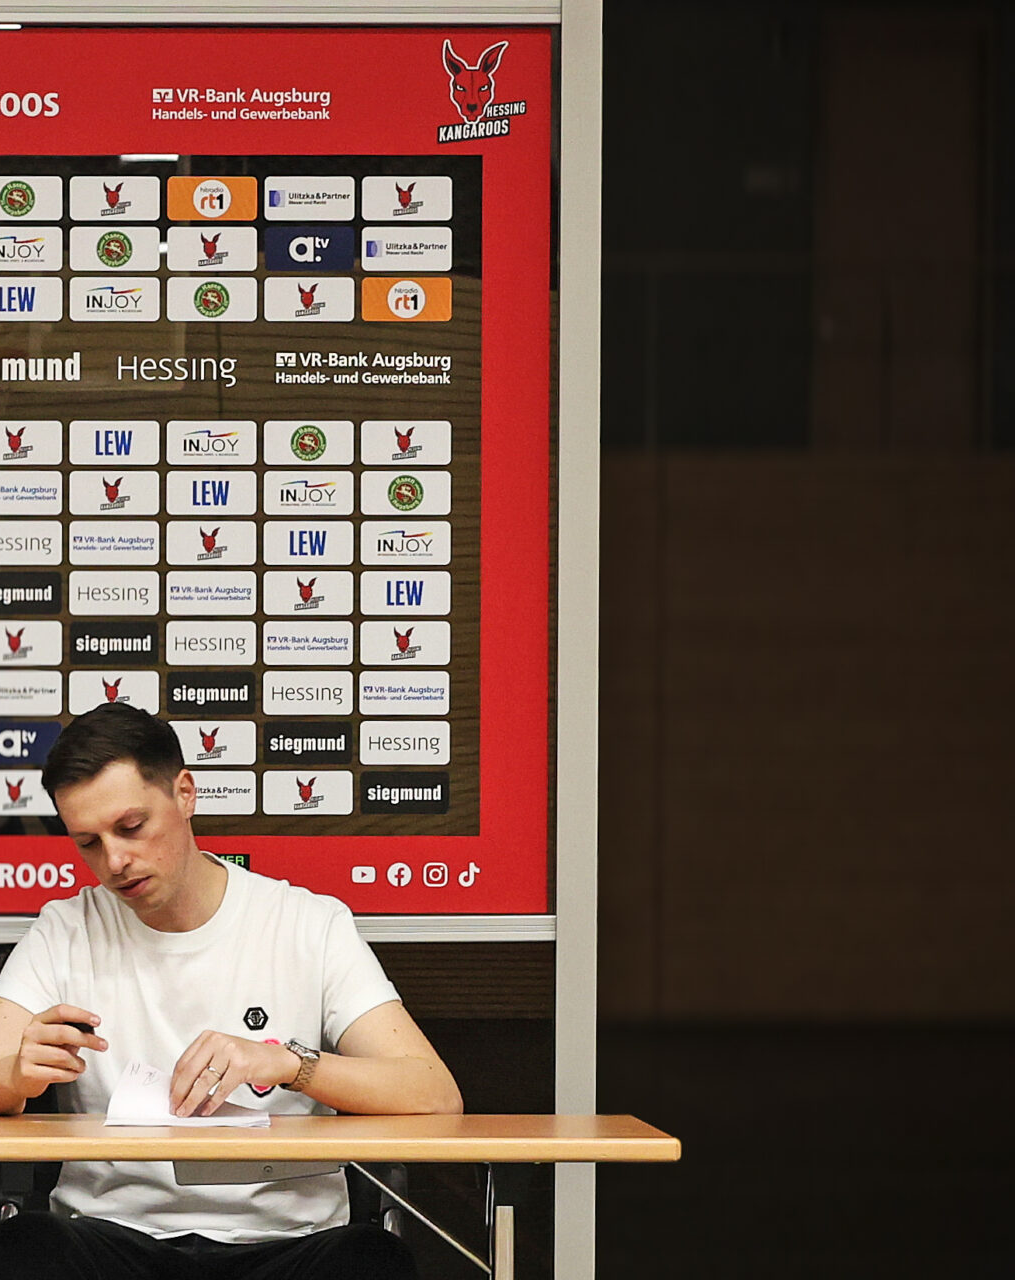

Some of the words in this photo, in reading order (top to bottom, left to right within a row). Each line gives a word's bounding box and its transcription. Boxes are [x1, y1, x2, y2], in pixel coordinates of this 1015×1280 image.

[177, 88, 245, 102] VR-Bank
[251, 88, 330, 106] Augsburg
[153, 108, 207, 119] Handels-
[212, 108, 236, 119] und
[240, 108, 329, 119] Gewerbebank
[487, 101, 526, 117] HESSING
[439, 118, 510, 142] KANGAROOS
[201, 194, 224, 209] rt1
[0, 287, 35, 312] LEW
[87, 295, 142, 308] INJOY
[395, 295, 418, 311] rt1
[300, 352, 368, 366] VR-Bank
[372, 352, 450, 371] Augsburg
[118, 356, 237, 387] Hessing
[276, 372, 329, 383] Handels-
[334, 372, 358, 383] und
[362, 372, 450, 384] Gewerbebank
[96, 431, 132, 455] LEW
[184, 439, 238, 452] INJOY
[21, 487, 57, 496] Augsburg
[193, 481, 229, 506] LEW
[281, 489, 335, 502] INJOY
[118, 537, 154, 547] Augsburg
[290, 531, 326, 556] LEW
[378, 539, 432, 552] INJOY
[78, 587, 148, 605] Hessing
[215, 587, 251, 597] Augsburg
[387, 581, 423, 606] LEW
[76, 635, 151, 655] siegmund
[175, 637, 245, 655] Hessing
[312, 637, 348, 646] Augsburg
[173, 685, 248, 704] siegmund
[272, 686, 343, 705] Hessing
[408, 687, 444, 697] Augsburg
[270, 735, 345, 754] siegmund
[369, 736, 440, 755] Hessing
[368, 785, 441, 804] siegmund
